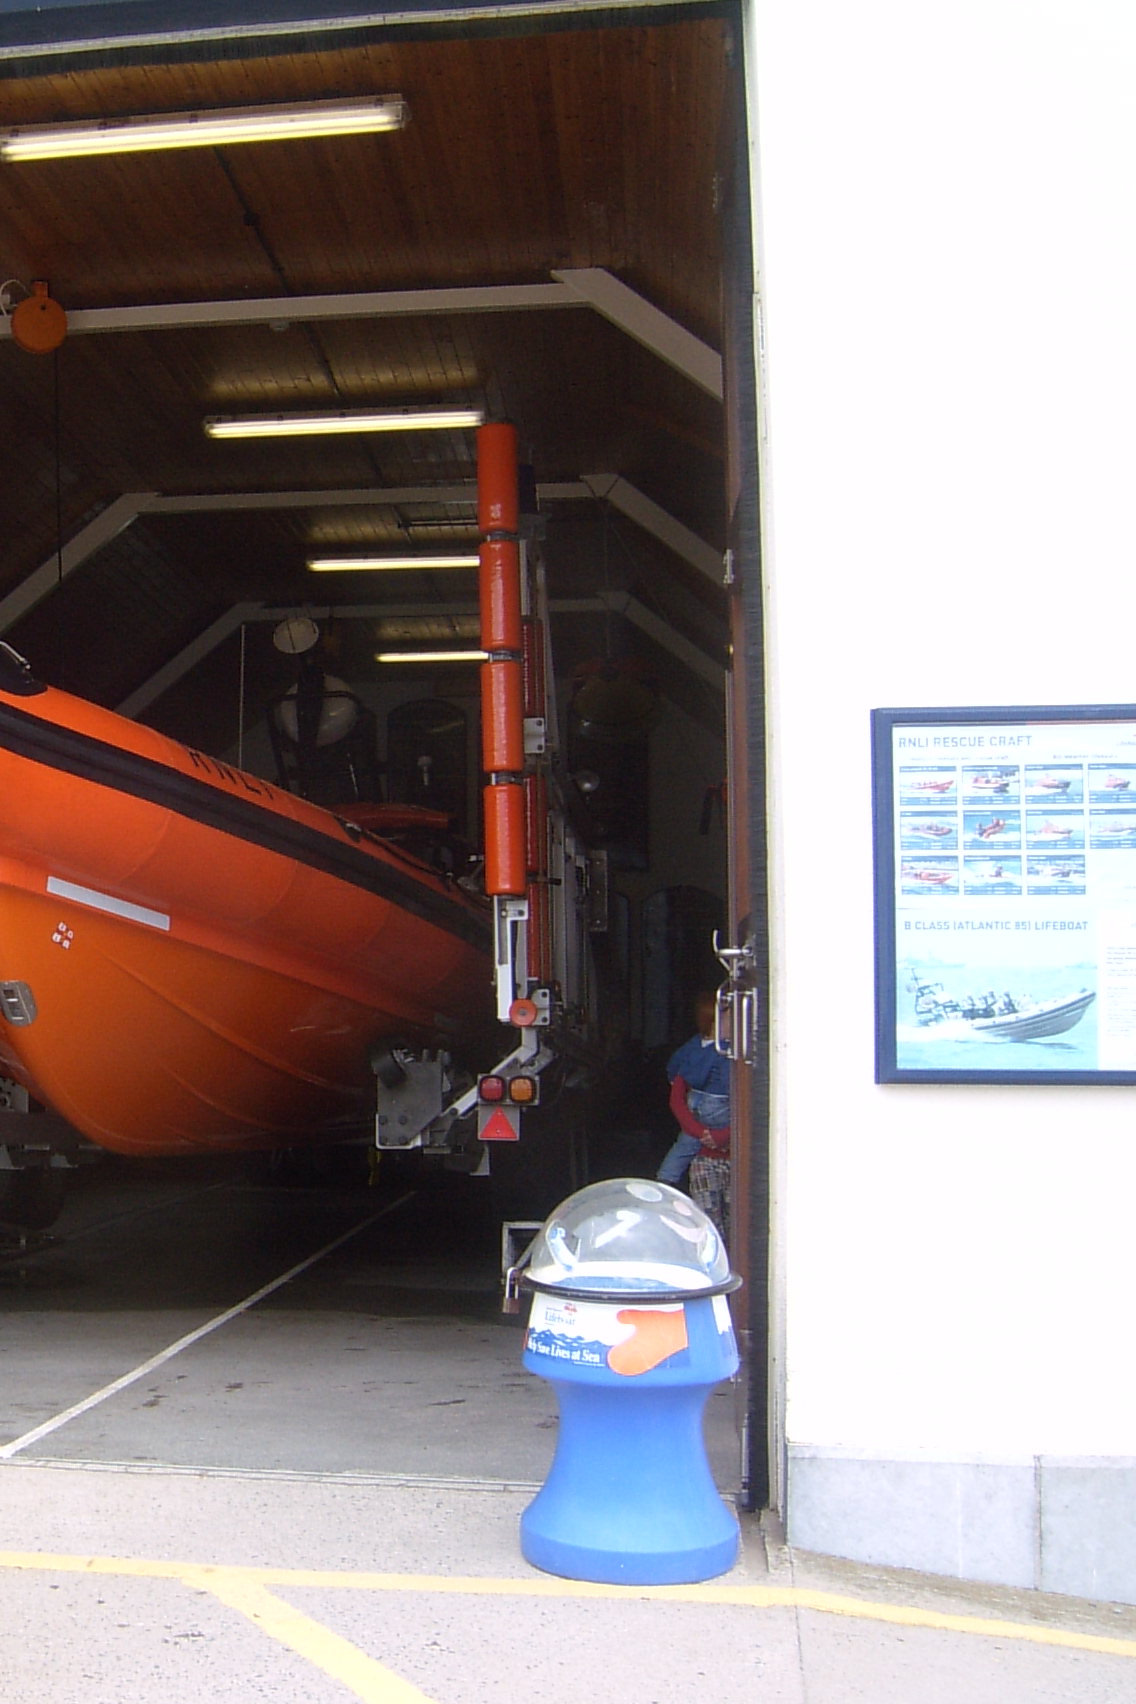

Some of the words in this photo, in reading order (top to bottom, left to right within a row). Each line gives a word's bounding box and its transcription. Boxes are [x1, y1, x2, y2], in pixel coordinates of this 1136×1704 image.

[898, 736, 929, 748] RNLI
[933, 735, 985, 748] RESCUE
[989, 735, 1033, 747] CRAFT
[904, 920, 912, 930] B
[914, 920, 950, 930] CLASS
[1034, 920, 1090, 931] LIFEBOAT
[550, 1343, 570, 1359] Lives
[571, 1349, 581, 1360] at
[582, 1349, 600, 1363] Sea
